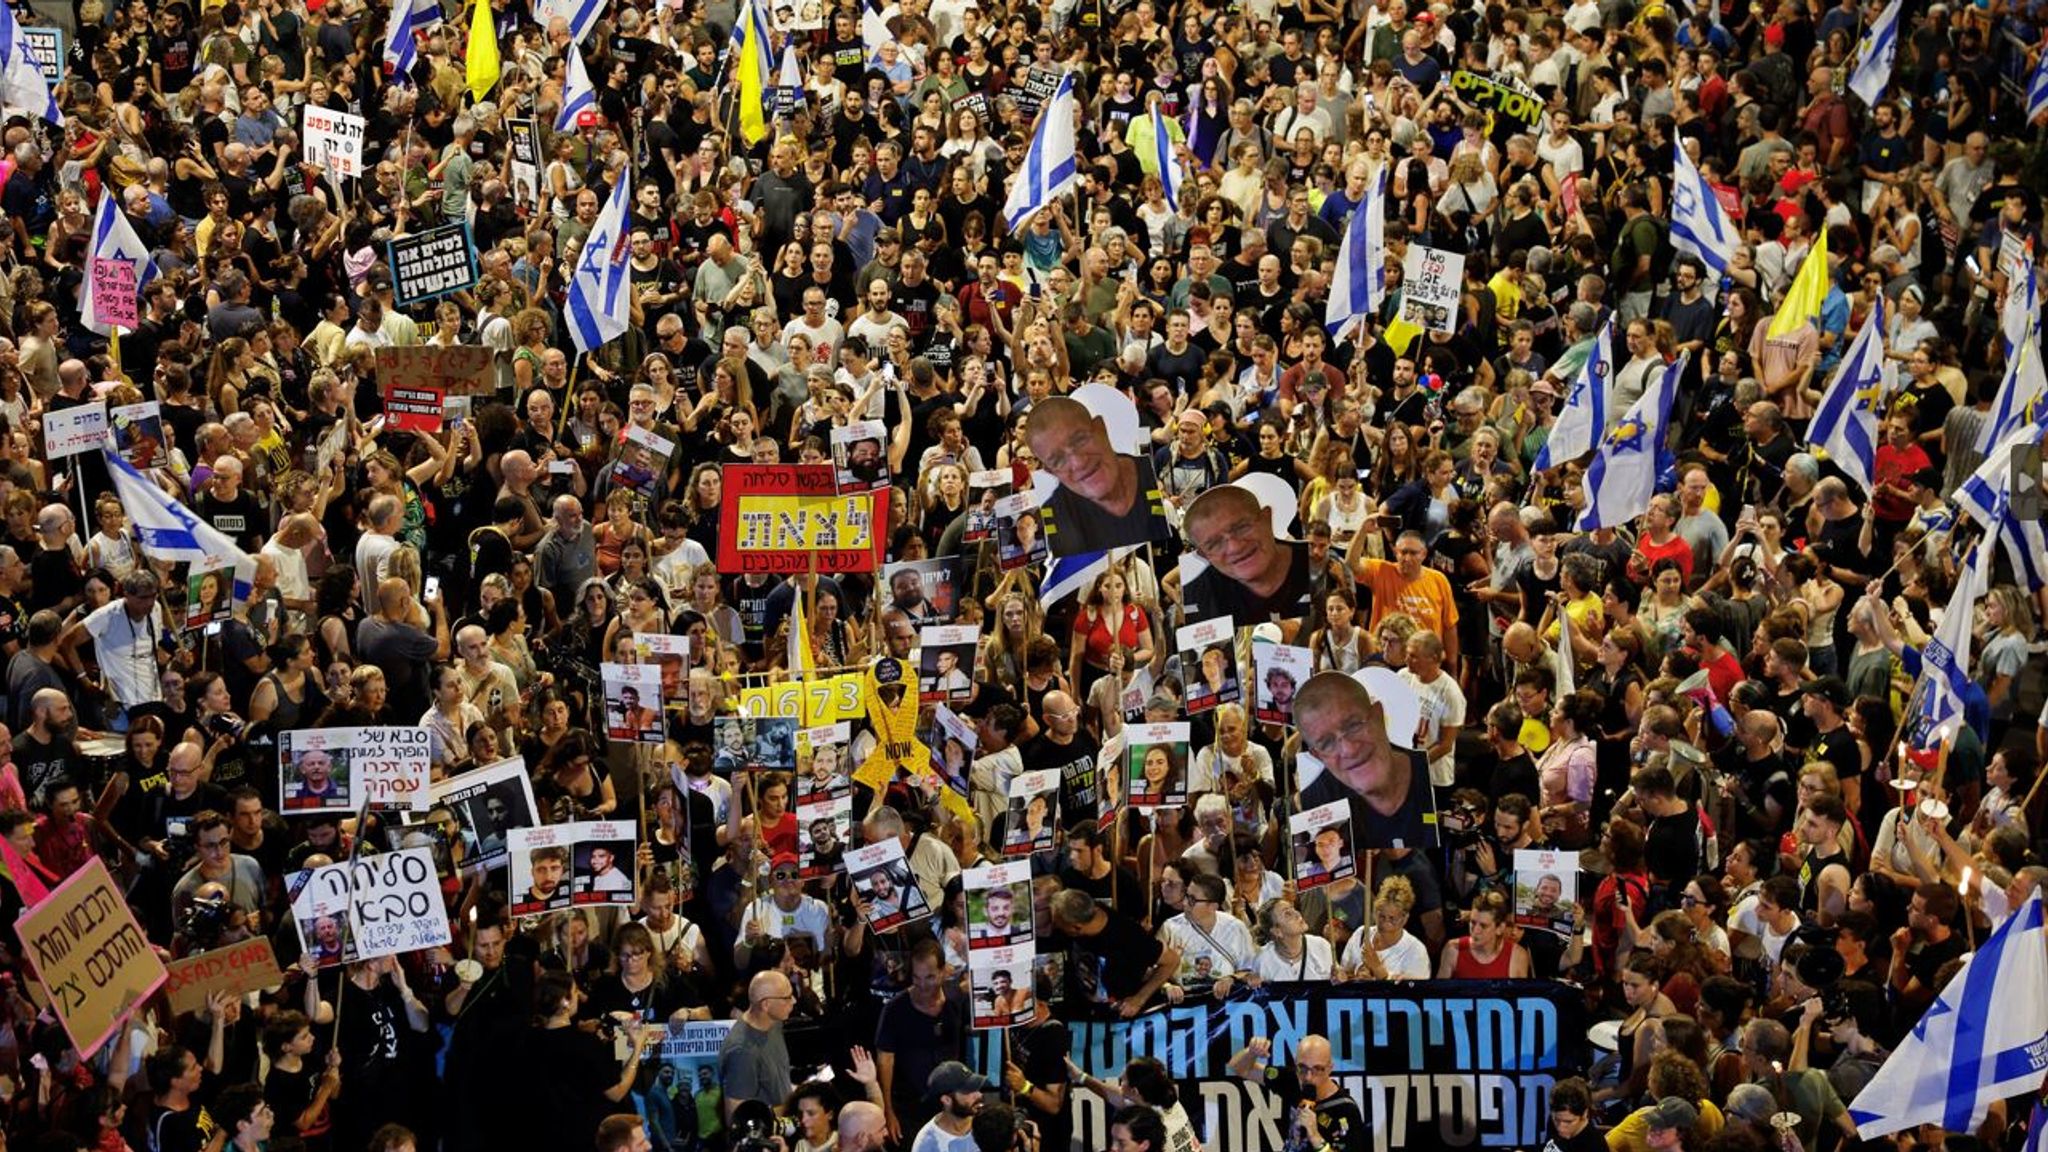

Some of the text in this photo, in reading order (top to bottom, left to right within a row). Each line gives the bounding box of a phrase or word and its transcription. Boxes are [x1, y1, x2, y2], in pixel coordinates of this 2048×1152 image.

[334, 115, 347, 135] לא
[350, 124, 362, 139] זה
[397, 234, 463, 264] לסיים את
[399, 250, 466, 279] המלחמה
[401, 265, 470, 299] עכשיו!
[74, 412, 101, 425] סדום
[744, 467, 790, 488] סליחה
[741, 498, 869, 548] לצאת
[745, 683, 859, 718] 0673
[358, 728, 428, 744] סבא שלי
[886, 741, 915, 760] NOW.
[363, 760, 399, 773] זכרו
[390, 746, 429, 760] הופקר
[363, 778, 420, 798] עסקה
[320, 853, 427, 896] סליחה
[355, 891, 430, 926] סבא
[84, 922, 145, 988] ההסכם
[166, 957, 224, 994] DEAD
[1225, 1000, 1309, 1076] את
[1327, 997, 1557, 1071] מחזירים
[1333, 1074, 1556, 1147] מפסיקי
